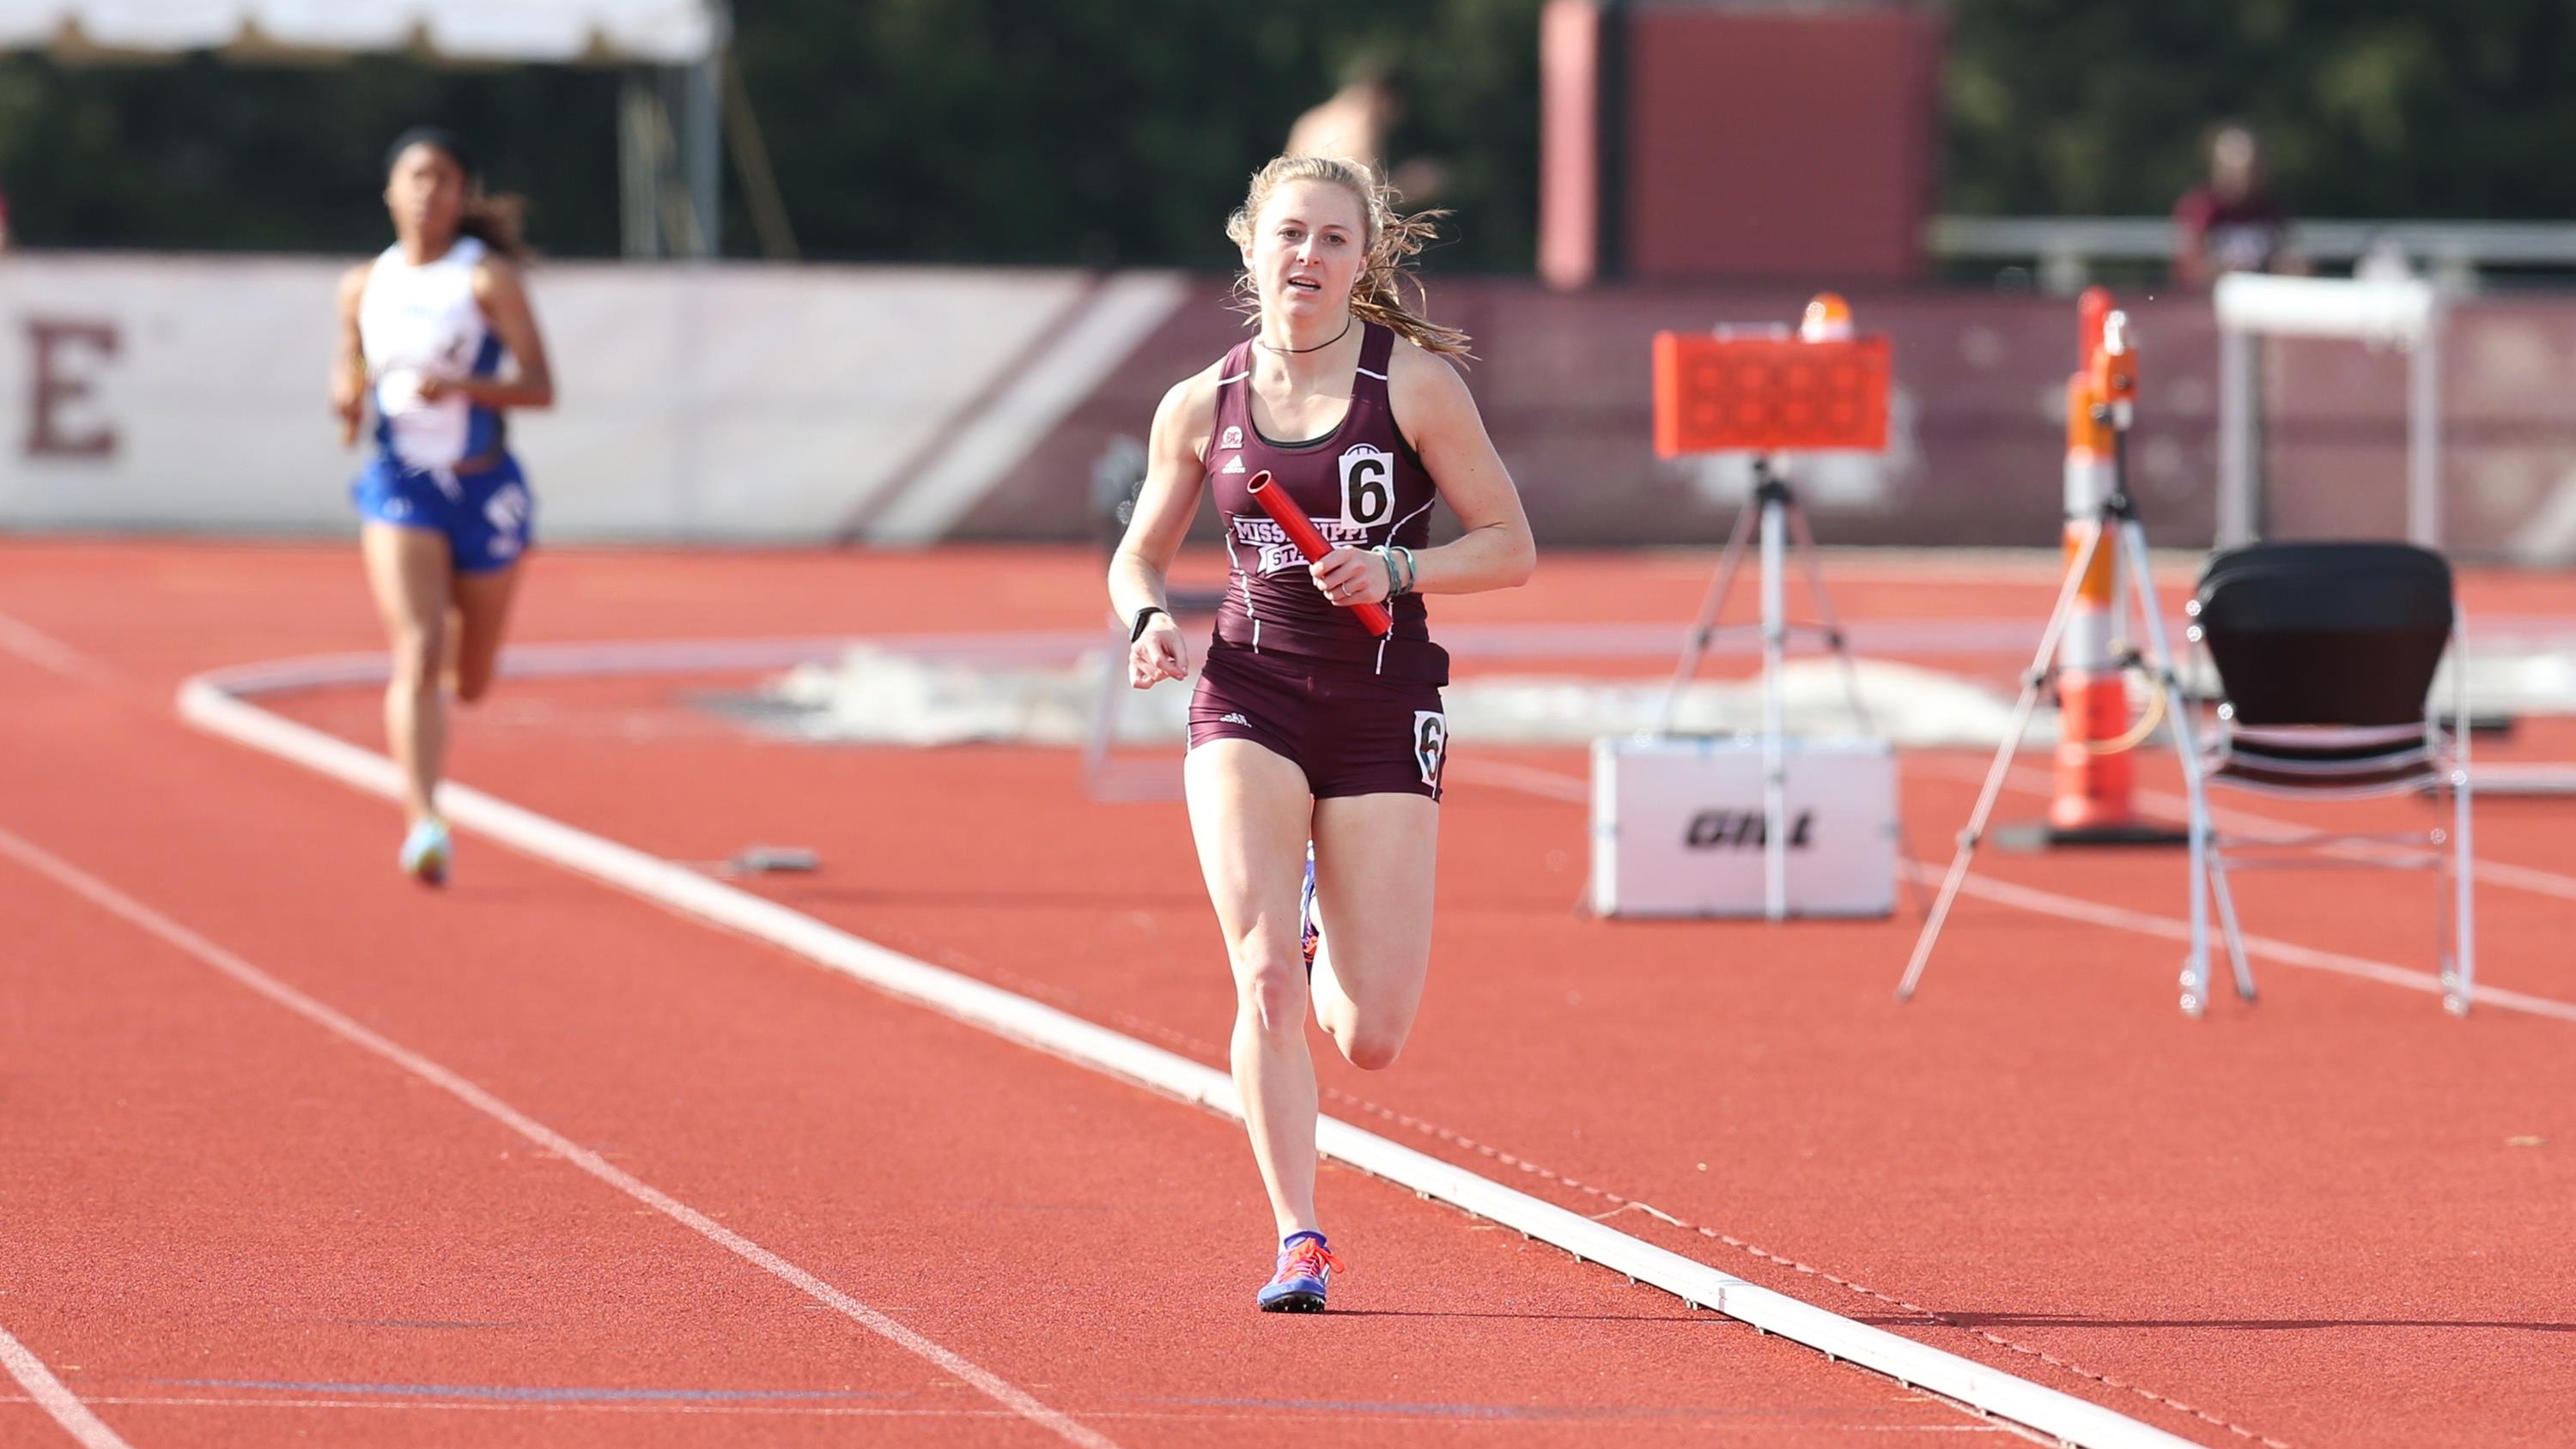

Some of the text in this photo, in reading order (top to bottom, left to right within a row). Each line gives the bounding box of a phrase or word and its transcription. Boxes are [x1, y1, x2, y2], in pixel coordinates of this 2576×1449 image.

[26, 318, 120, 461] E
[1348, 458, 1388, 524] 6
[1234, 521, 1368, 543] MISSIPPI
[1419, 717, 1441, 781] 6
[1685, 809, 1814, 846] GIL
